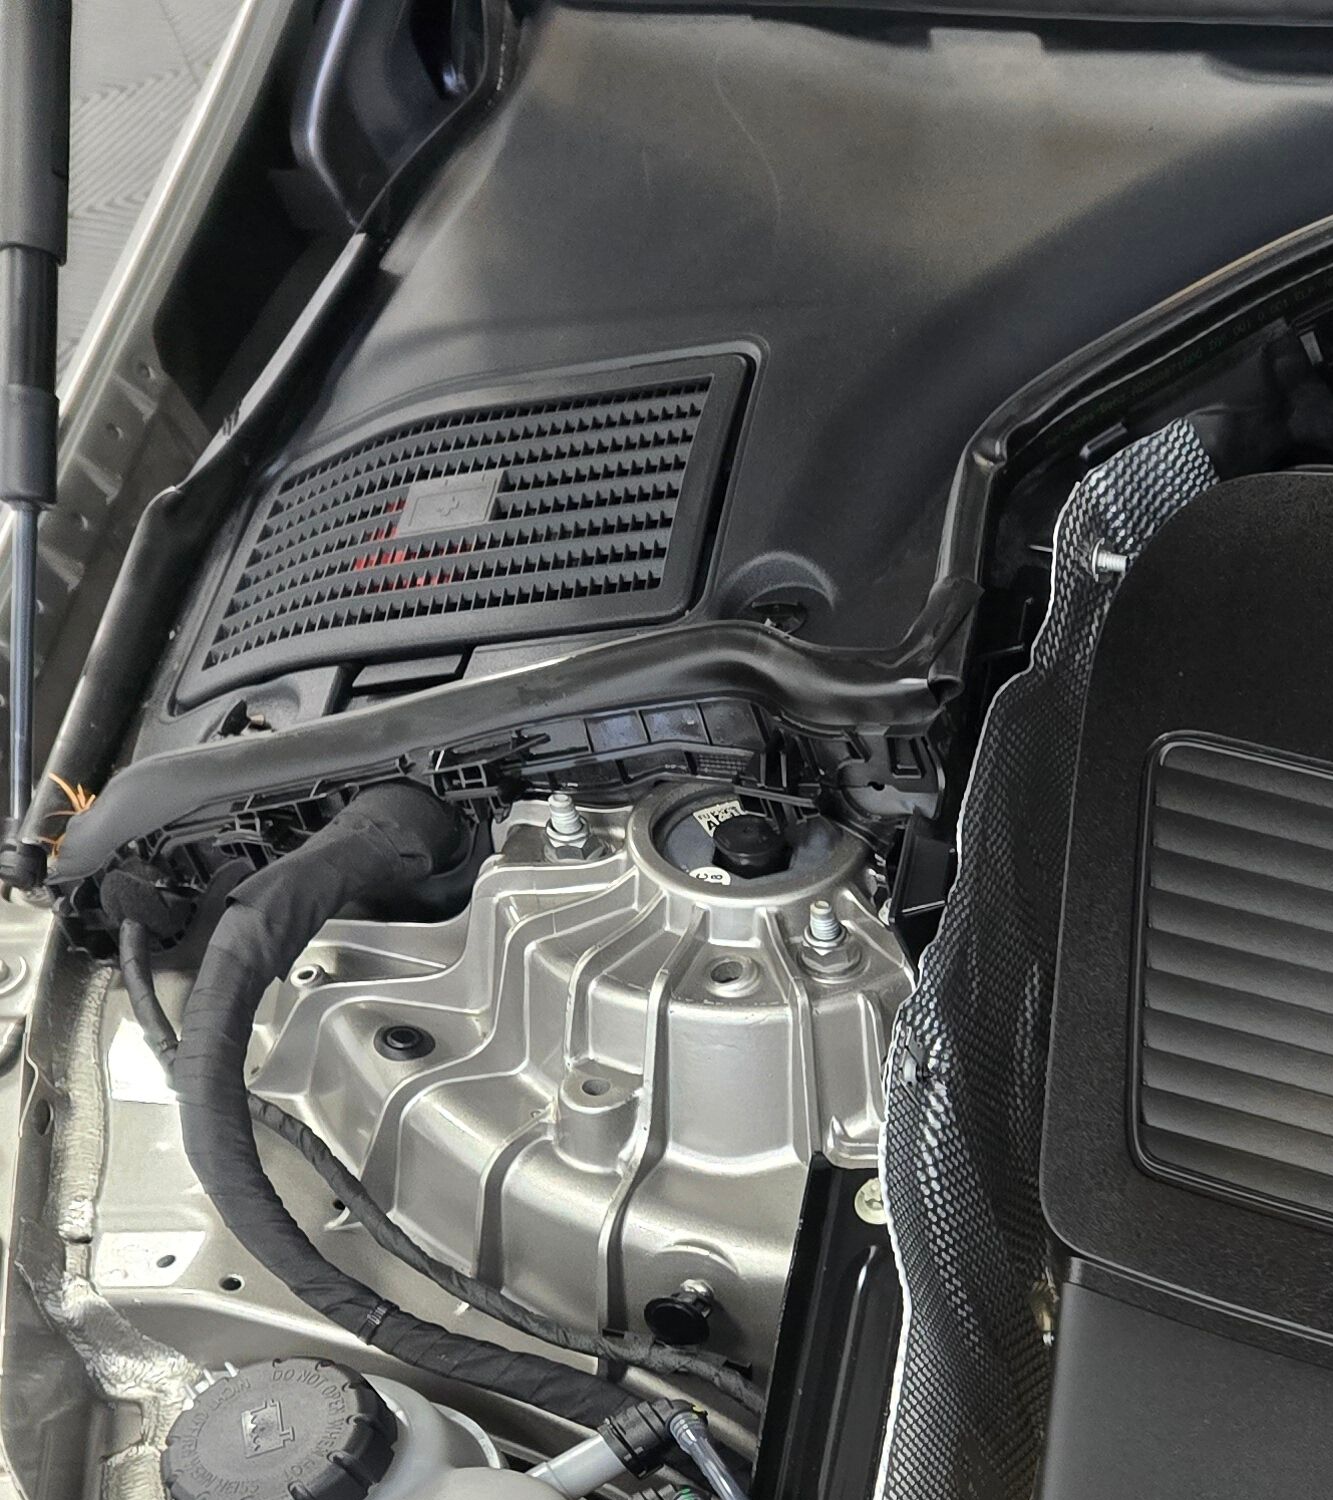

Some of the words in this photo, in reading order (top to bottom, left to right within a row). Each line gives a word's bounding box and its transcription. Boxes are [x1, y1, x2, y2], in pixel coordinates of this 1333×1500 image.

[272, 1369, 295, 1381] DO
[299, 1369, 328, 1388] NOT
[321, 1384, 346, 1413] OPEN
